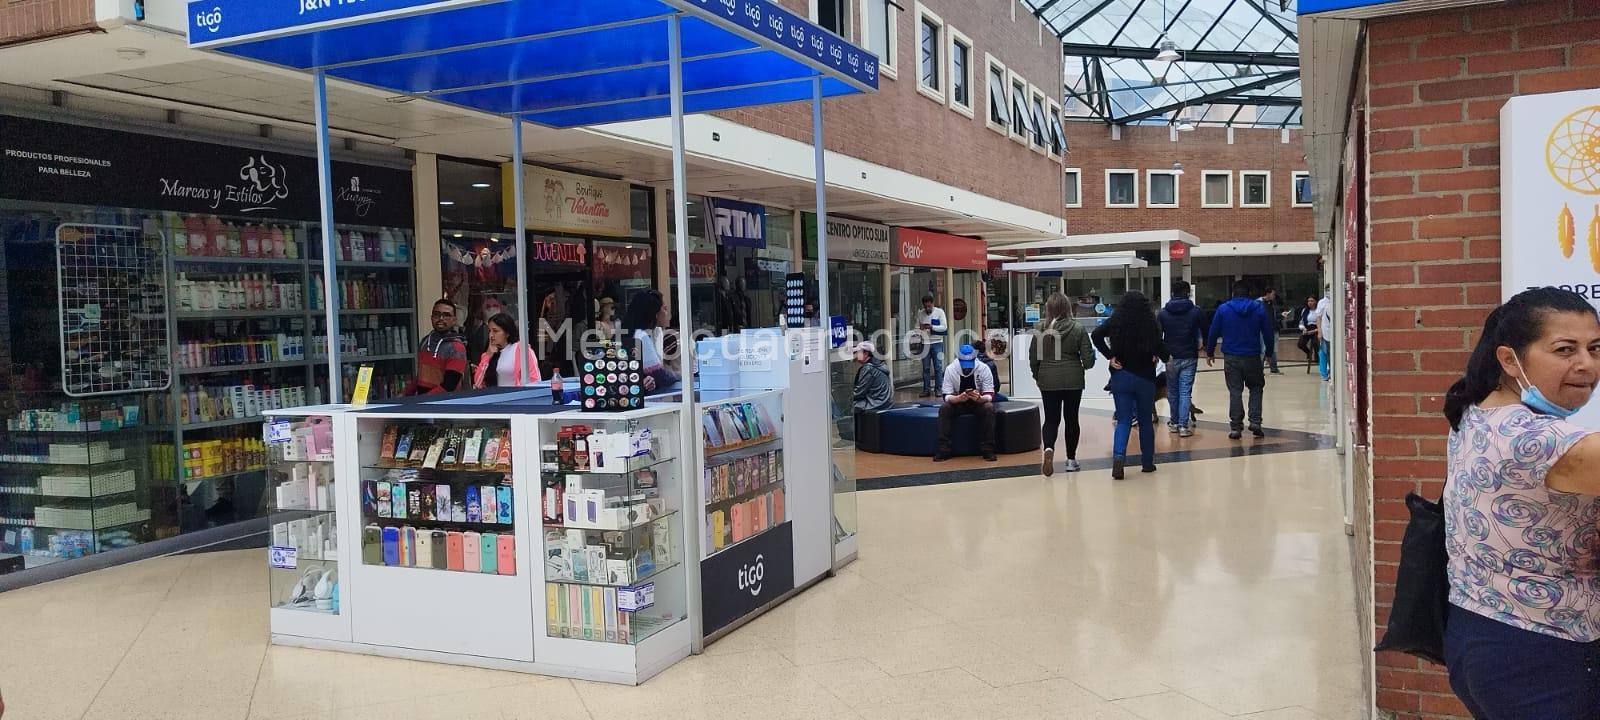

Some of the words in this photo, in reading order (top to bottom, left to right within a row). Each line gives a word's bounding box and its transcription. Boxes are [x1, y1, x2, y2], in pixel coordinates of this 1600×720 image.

[5, 149, 53, 162] PRODUCTOS
[54, 154, 112, 168] PROFESIONALES
[38, 166, 59, 176] PARA
[60, 168, 92, 178] BELLEZA
[159, 177, 211, 200] Marcas
[209, 188, 222, 209] y
[225, 184, 263, 204] Estilos
[576, 182, 604, 200] Boutique
[713, 207, 762, 240] RTM
[826, 221, 851, 239] CENTRO
[852, 225, 874, 242] OPTICO
[874, 229, 889, 243] SUBA
[902, 240, 921, 260] Claro
[833, 326, 846, 339] VISA
[738, 553, 764, 596] tigo
